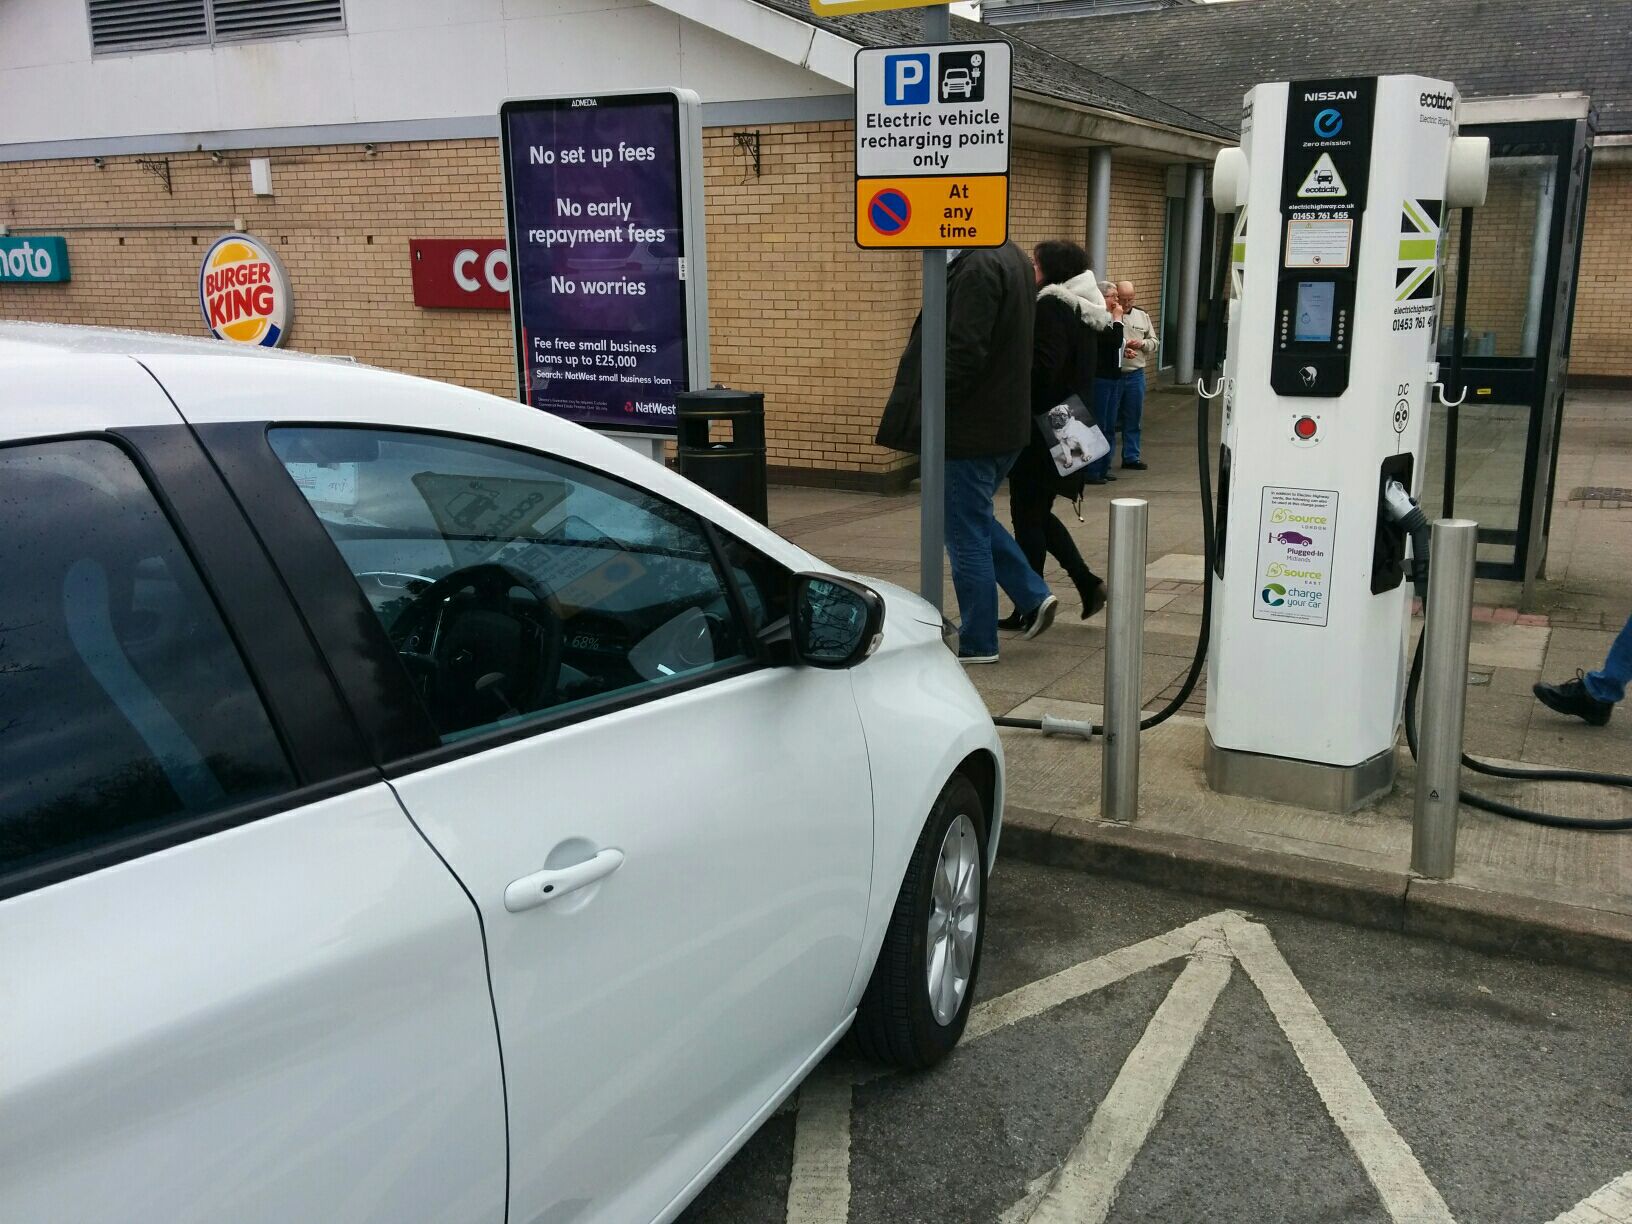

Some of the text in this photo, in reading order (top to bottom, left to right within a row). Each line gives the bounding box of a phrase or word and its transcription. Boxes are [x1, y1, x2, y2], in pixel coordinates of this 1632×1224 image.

[896, 60, 924, 100] P
[1304, 90, 1358, 102] NISSAN
[866, 110, 1000, 128] Electric vehicle
[861, 129, 1004, 149] recharging point
[530, 142, 655, 168] No set up fees
[913, 151, 949, 168] only
[949, 184, 969, 199] At
[1305, 186, 1339, 194] ecotricity
[557, 197, 632, 221] No early
[944, 207, 973, 221] any
[529, 223, 666, 248] repayment fees
[939, 224, 977, 238] time
[206, 263, 270, 297] BURGER
[551, 276, 646, 295] No worries
[210, 285, 274, 328] KING
[1393, 318, 1413, 331] 01453
[1415, 316, 1425, 329] 761
[534, 337, 656, 353] Fee free small business
[536, 352, 637, 368] loans up to £25,000
[536, 370, 672, 385] Search: NatWest small business loan
[1398, 383, 1409, 396] DC
[636, 402, 676, 415] NatWest
[1288, 514, 1327, 524] source
[1284, 569, 1322, 579] source
[1288, 588, 1322, 601] charge
[1287, 599, 1305, 607] your
[572, 636, 599, 649] 68%
